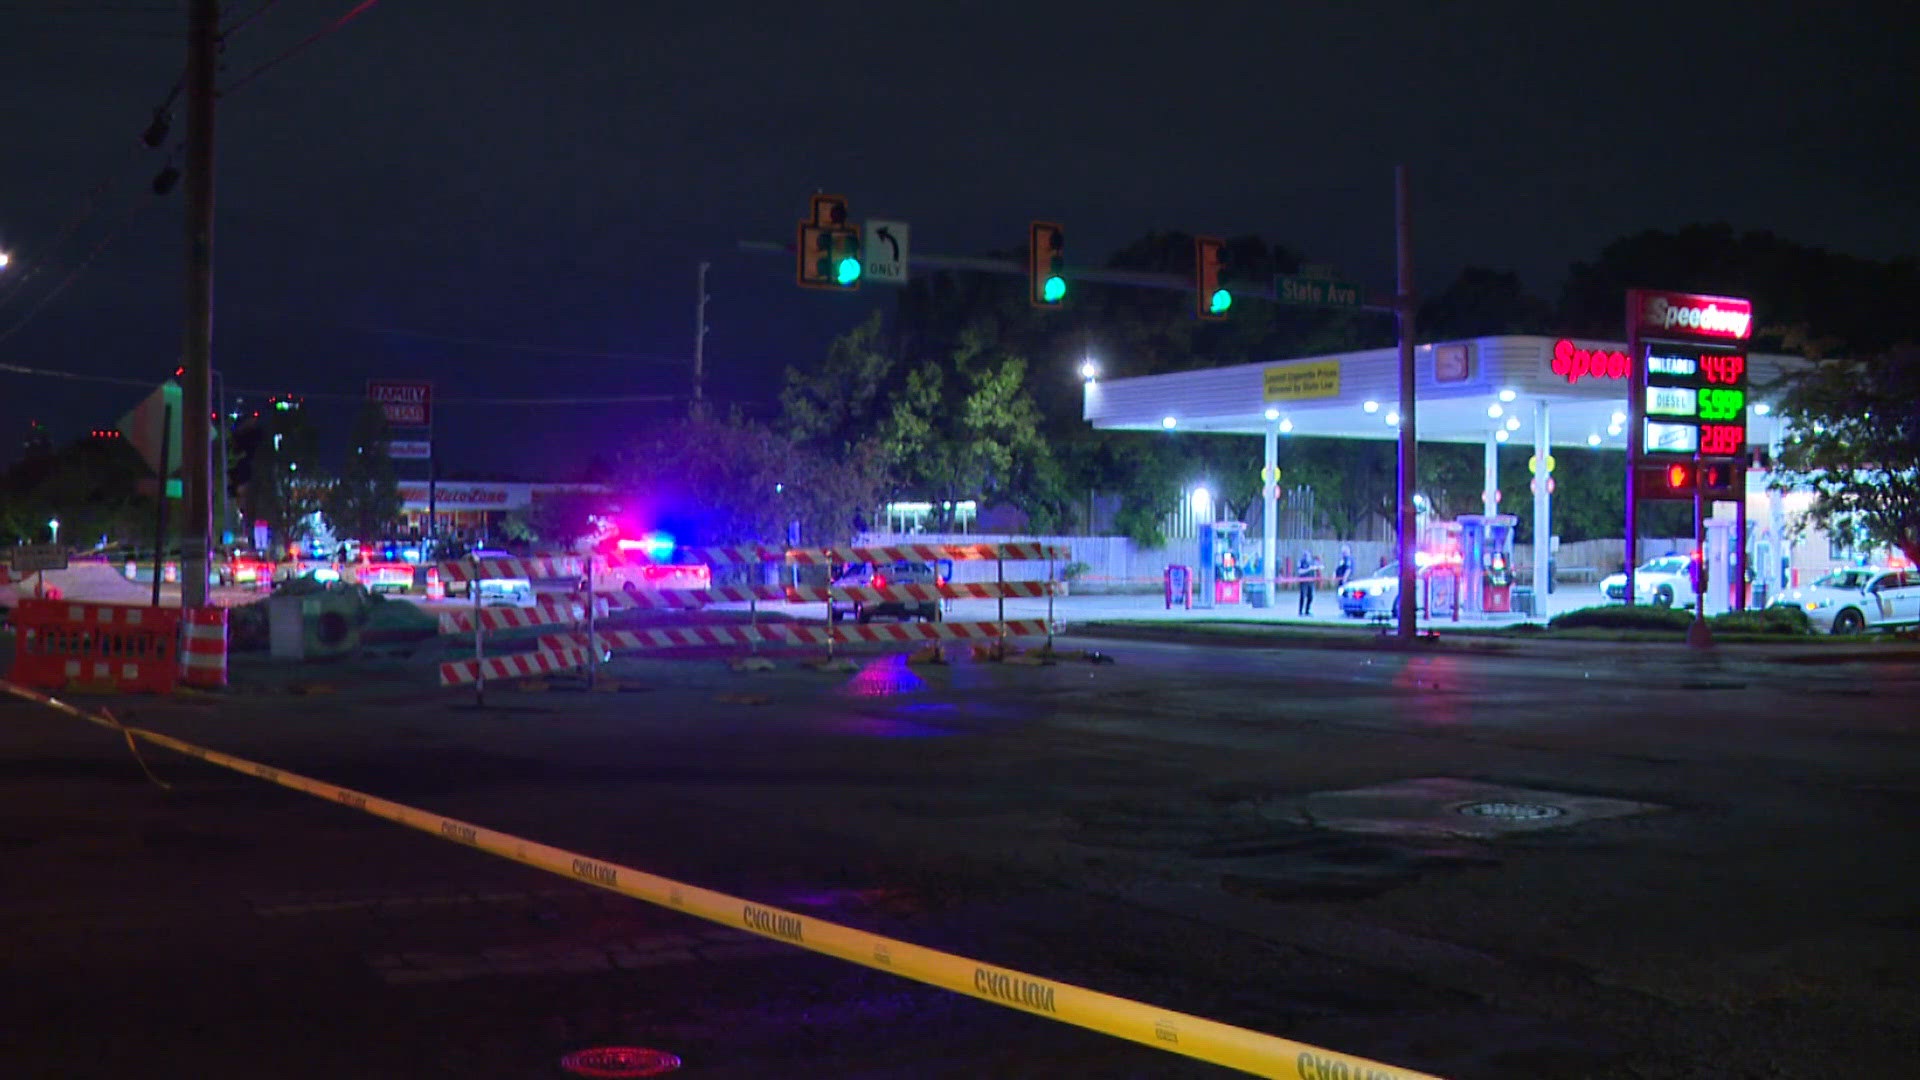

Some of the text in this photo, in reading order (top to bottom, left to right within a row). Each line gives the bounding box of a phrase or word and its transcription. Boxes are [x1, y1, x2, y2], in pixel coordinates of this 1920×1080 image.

[870, 262, 900, 277] ONLY
[1281, 279, 1356, 305] State Ave
[1649, 297, 1750, 338] Speedway
[1656, 394, 1686, 408] DIESEL
